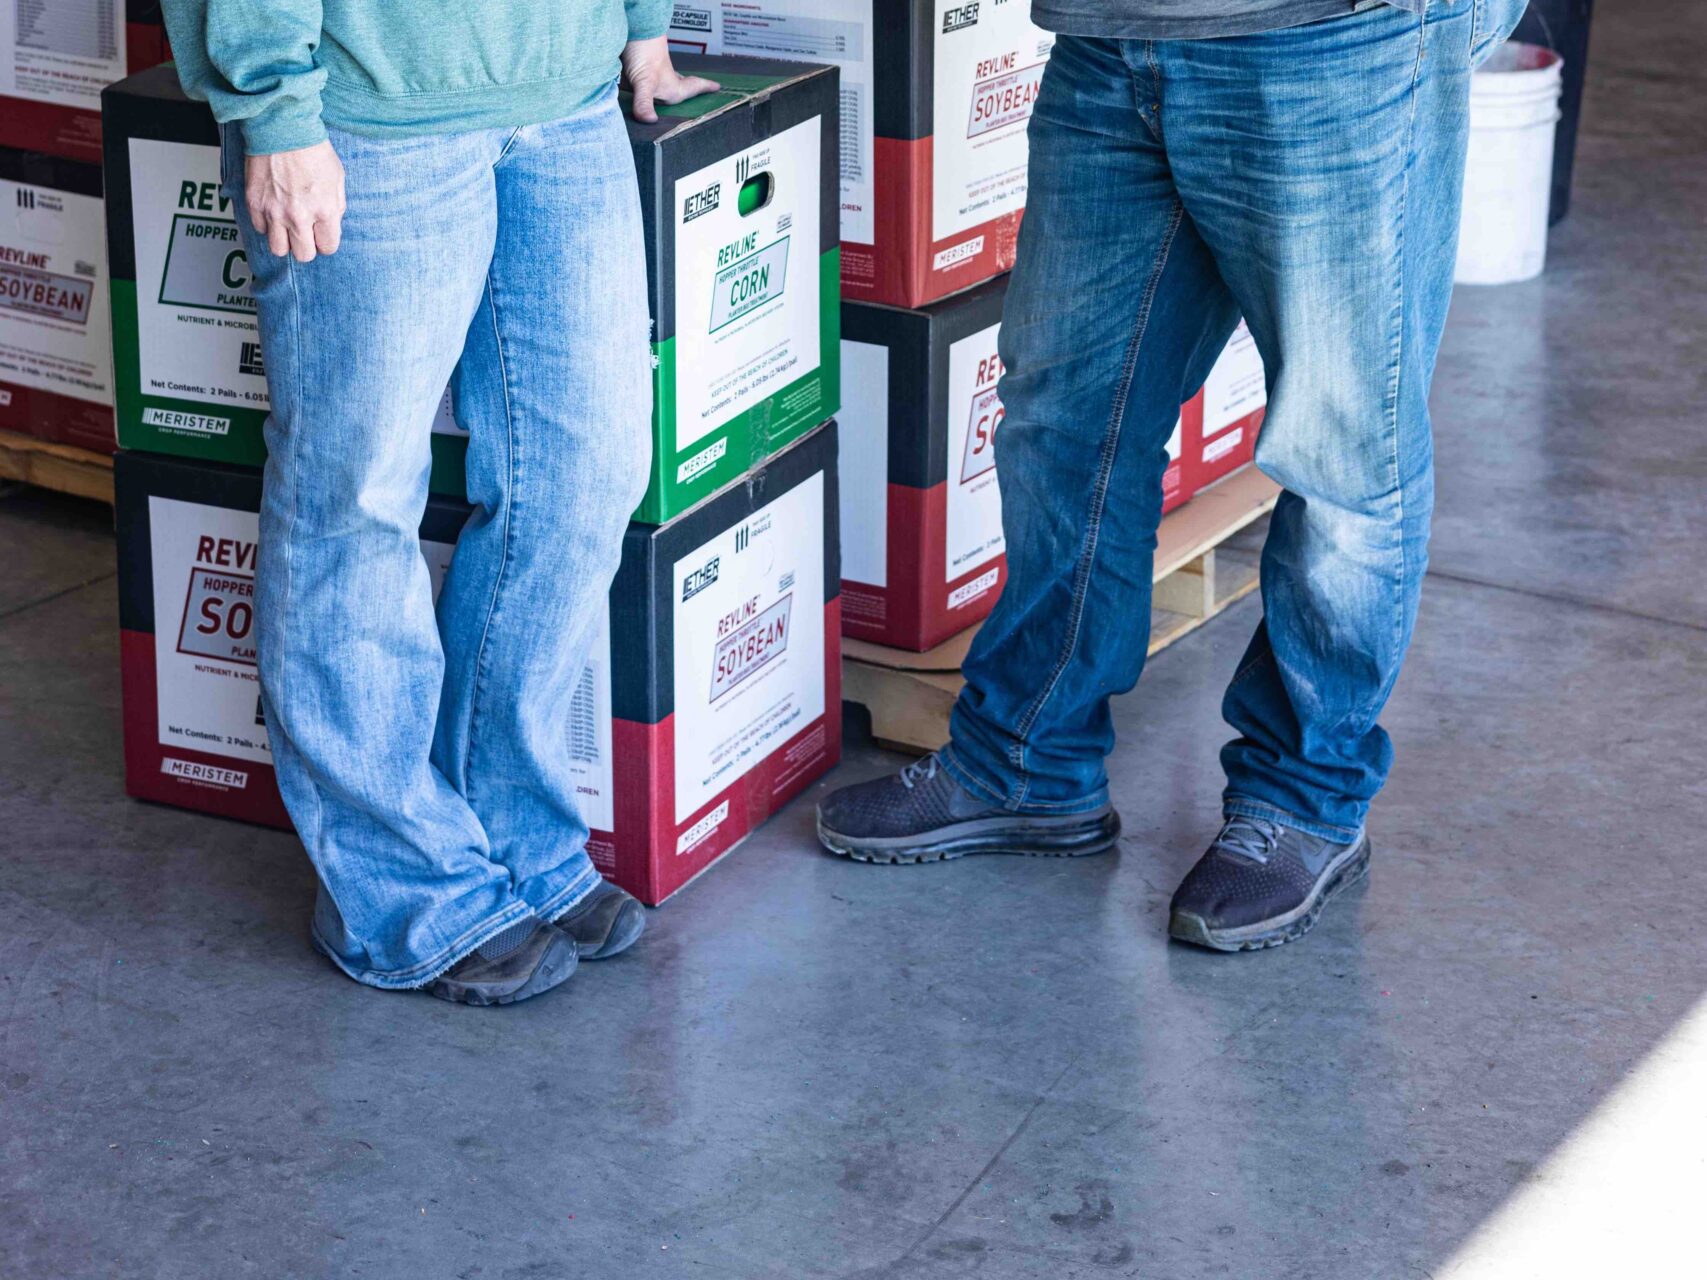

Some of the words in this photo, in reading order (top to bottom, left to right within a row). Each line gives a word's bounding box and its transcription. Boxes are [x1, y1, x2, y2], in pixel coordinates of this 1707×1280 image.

[976, 52, 1015, 80] REVLINE
[751, 156, 771, 171] FRAGILE
[185, 223, 239, 241] HOPPER
[717, 230, 757, 268] REVLINE
[940, 239, 982, 263] MERISTEM
[719, 268, 737, 284] HOPPER
[738, 257, 759, 277] THROTTLE
[0, 276, 84, 312] SOYBEAN
[730, 263, 770, 307] CORN
[177, 314, 216, 326] NUTRIENT
[151, 379, 165, 389] Net
[168, 382, 206, 394] Contents:
[218, 388, 237, 399] Pails
[153, 411, 227, 432] MERISTEM
[701, 410, 710, 418] Net
[173, 429, 211, 439] PERFORMANCE
[683, 441, 725, 473] MERISTEM
[203, 577, 254, 598] HOPPER
[717, 594, 758, 638] REVLINE
[716, 613, 786, 683] SOYBEAN
[194, 664, 232, 677] NUTRIENT
[168, 724, 183, 735] Net
[184, 728, 223, 742] Contents:
[226, 736, 232, 745] 2
[234, 737, 253, 748] Pails
[171, 761, 244, 785] MERISTEM
[684, 804, 727, 841] MERISTEM
